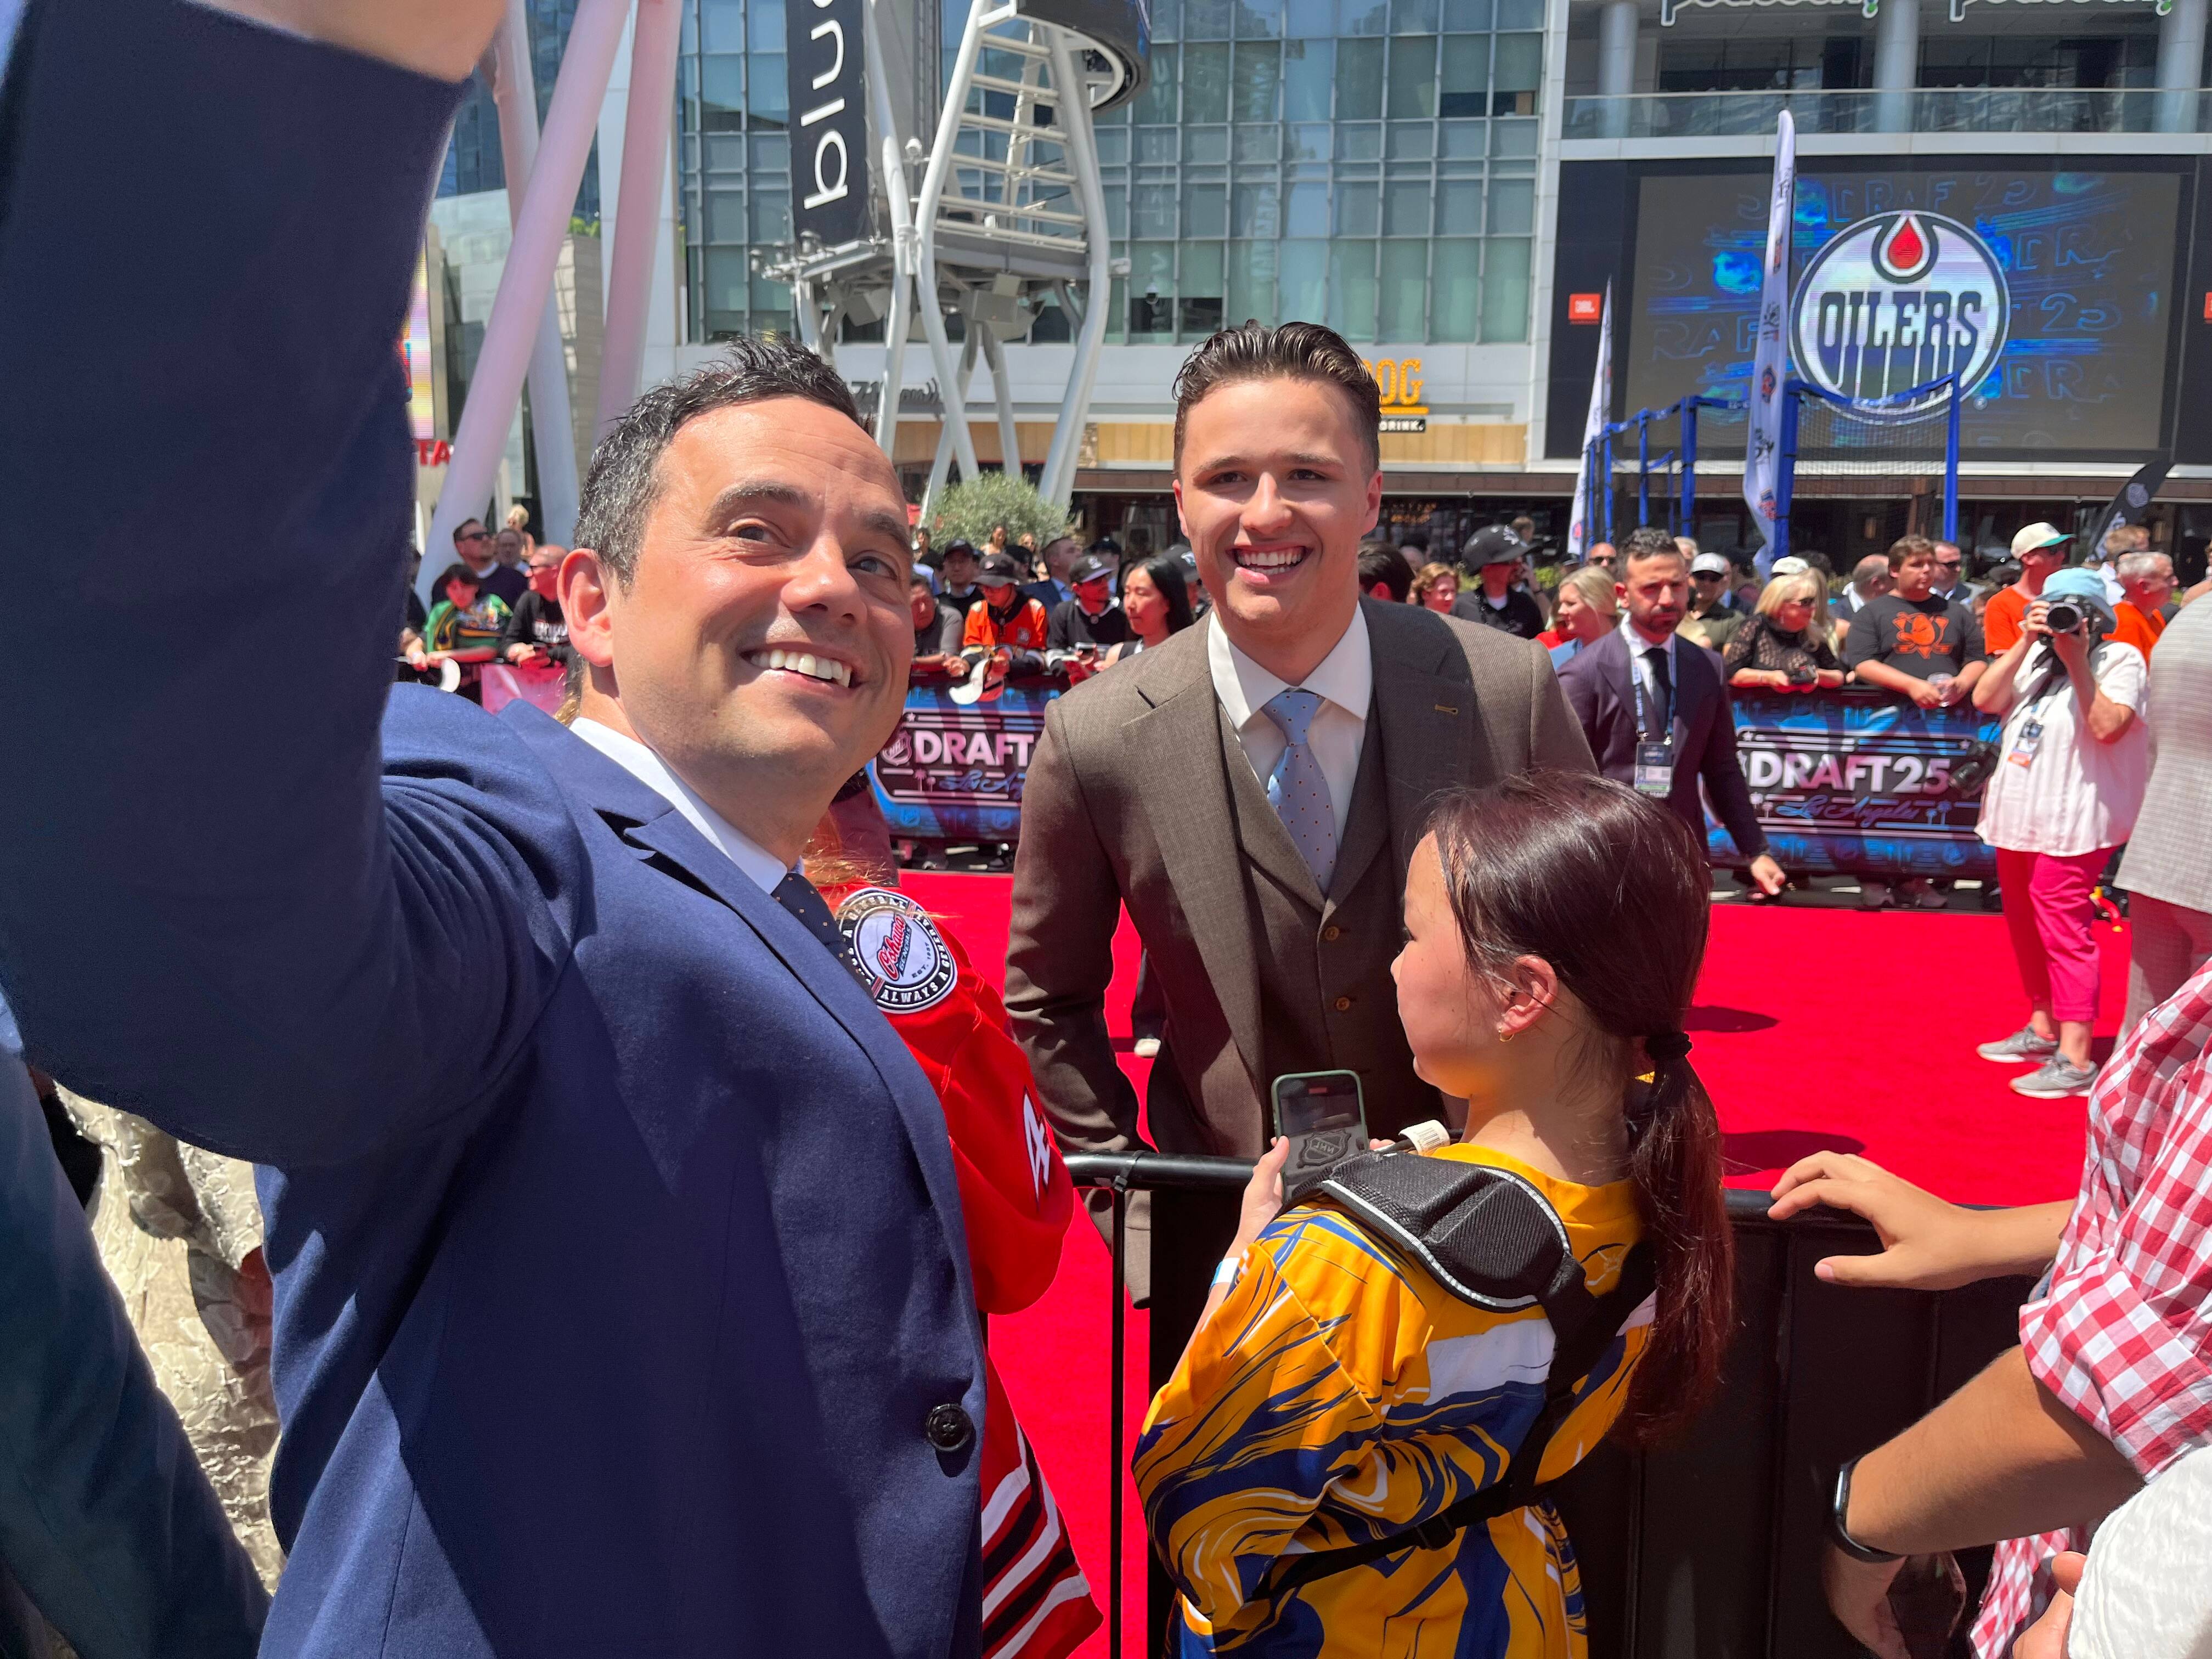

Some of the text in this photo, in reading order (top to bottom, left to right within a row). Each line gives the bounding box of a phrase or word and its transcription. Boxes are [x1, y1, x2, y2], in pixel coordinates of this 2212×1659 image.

[800, 0, 849, 210] blu
[1818, 290, 1982, 379] OILERS
[1364, 358, 1424, 405] OG
[914, 730, 1034, 766] DRAFT
[880, 981, 939, 1003] ALWAYS
